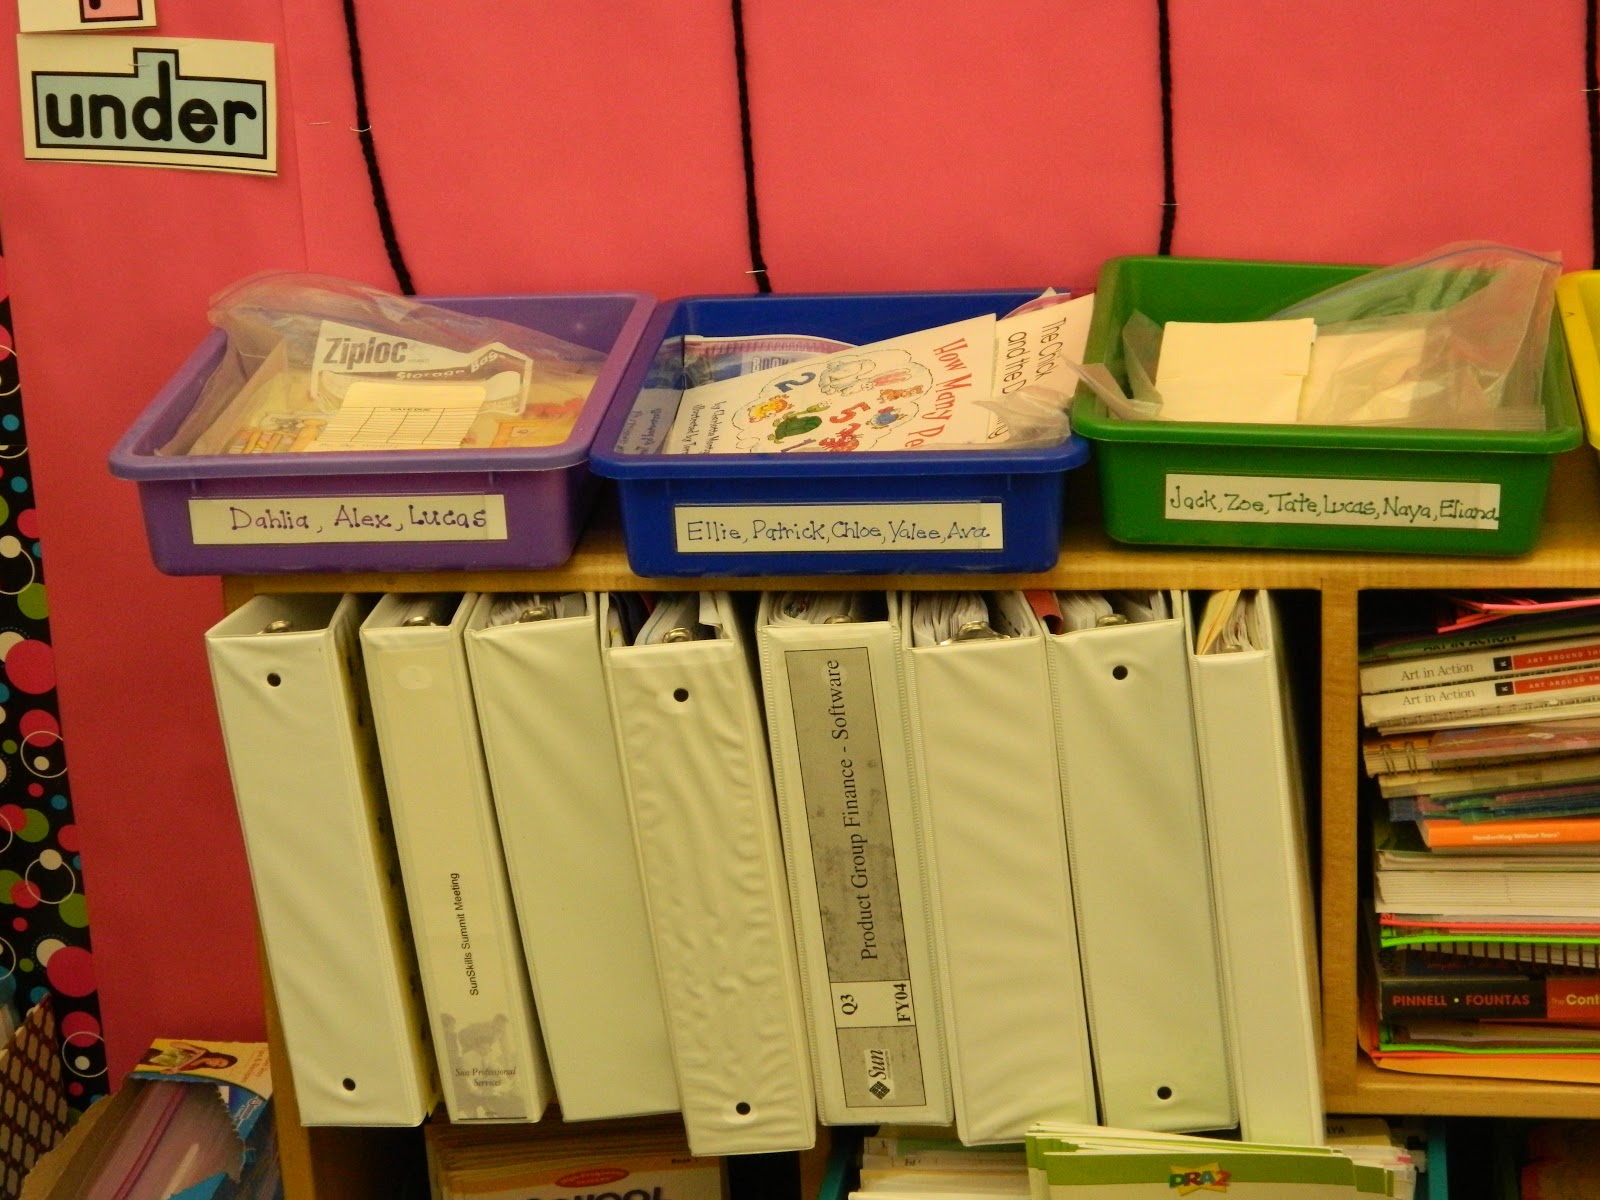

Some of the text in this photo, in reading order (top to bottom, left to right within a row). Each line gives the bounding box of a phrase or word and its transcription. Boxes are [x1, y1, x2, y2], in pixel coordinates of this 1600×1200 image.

[46, 60, 257, 146] under
[322, 336, 409, 370] Ziploc
[933, 337, 969, 372] How
[1006, 331, 1031, 358] and
[1034, 317, 1067, 382] The Chick
[396, 369, 465, 380] Storage
[1002, 357, 1030, 383] the
[922, 373, 972, 421] Many
[334, 504, 403, 532] Alex,
[408, 504, 488, 529] Lucas
[1169, 485, 1222, 514] Jack,
[1268, 492, 1321, 517] Tate,
[1323, 494, 1380, 520] Lucas,
[1382, 495, 1437, 523] Naya,
[687, 521, 749, 543] Ellie,
[751, 519, 830, 543] Patrick,
[831, 520, 886, 544] Chloe,
[947, 521, 990, 539] Ava
[1401, 663, 1474, 682] Art in Action
[1527, 656, 1543, 664] ART
[1547, 651, 1583, 661] AROUND
[1402, 688, 1475, 706] Art in Action
[1529, 681, 1546, 689] ART
[1549, 676, 1586, 687] AROUND
[828, 659, 849, 740] Software
[840, 758, 861, 828] Finance
[850, 833, 868, 889] Group
[450, 872, 479, 996] SunSkills Summit Meeting
[857, 893, 878, 961] Product
[840, 994, 858, 1015] Q3
[893, 983, 911, 1022] FY04
[1392, 993, 1530, 1007] PINNELL FOUNTAS
[869, 1050, 887, 1080] Sun
[1169, 1170, 1232, 1188] DRA2
